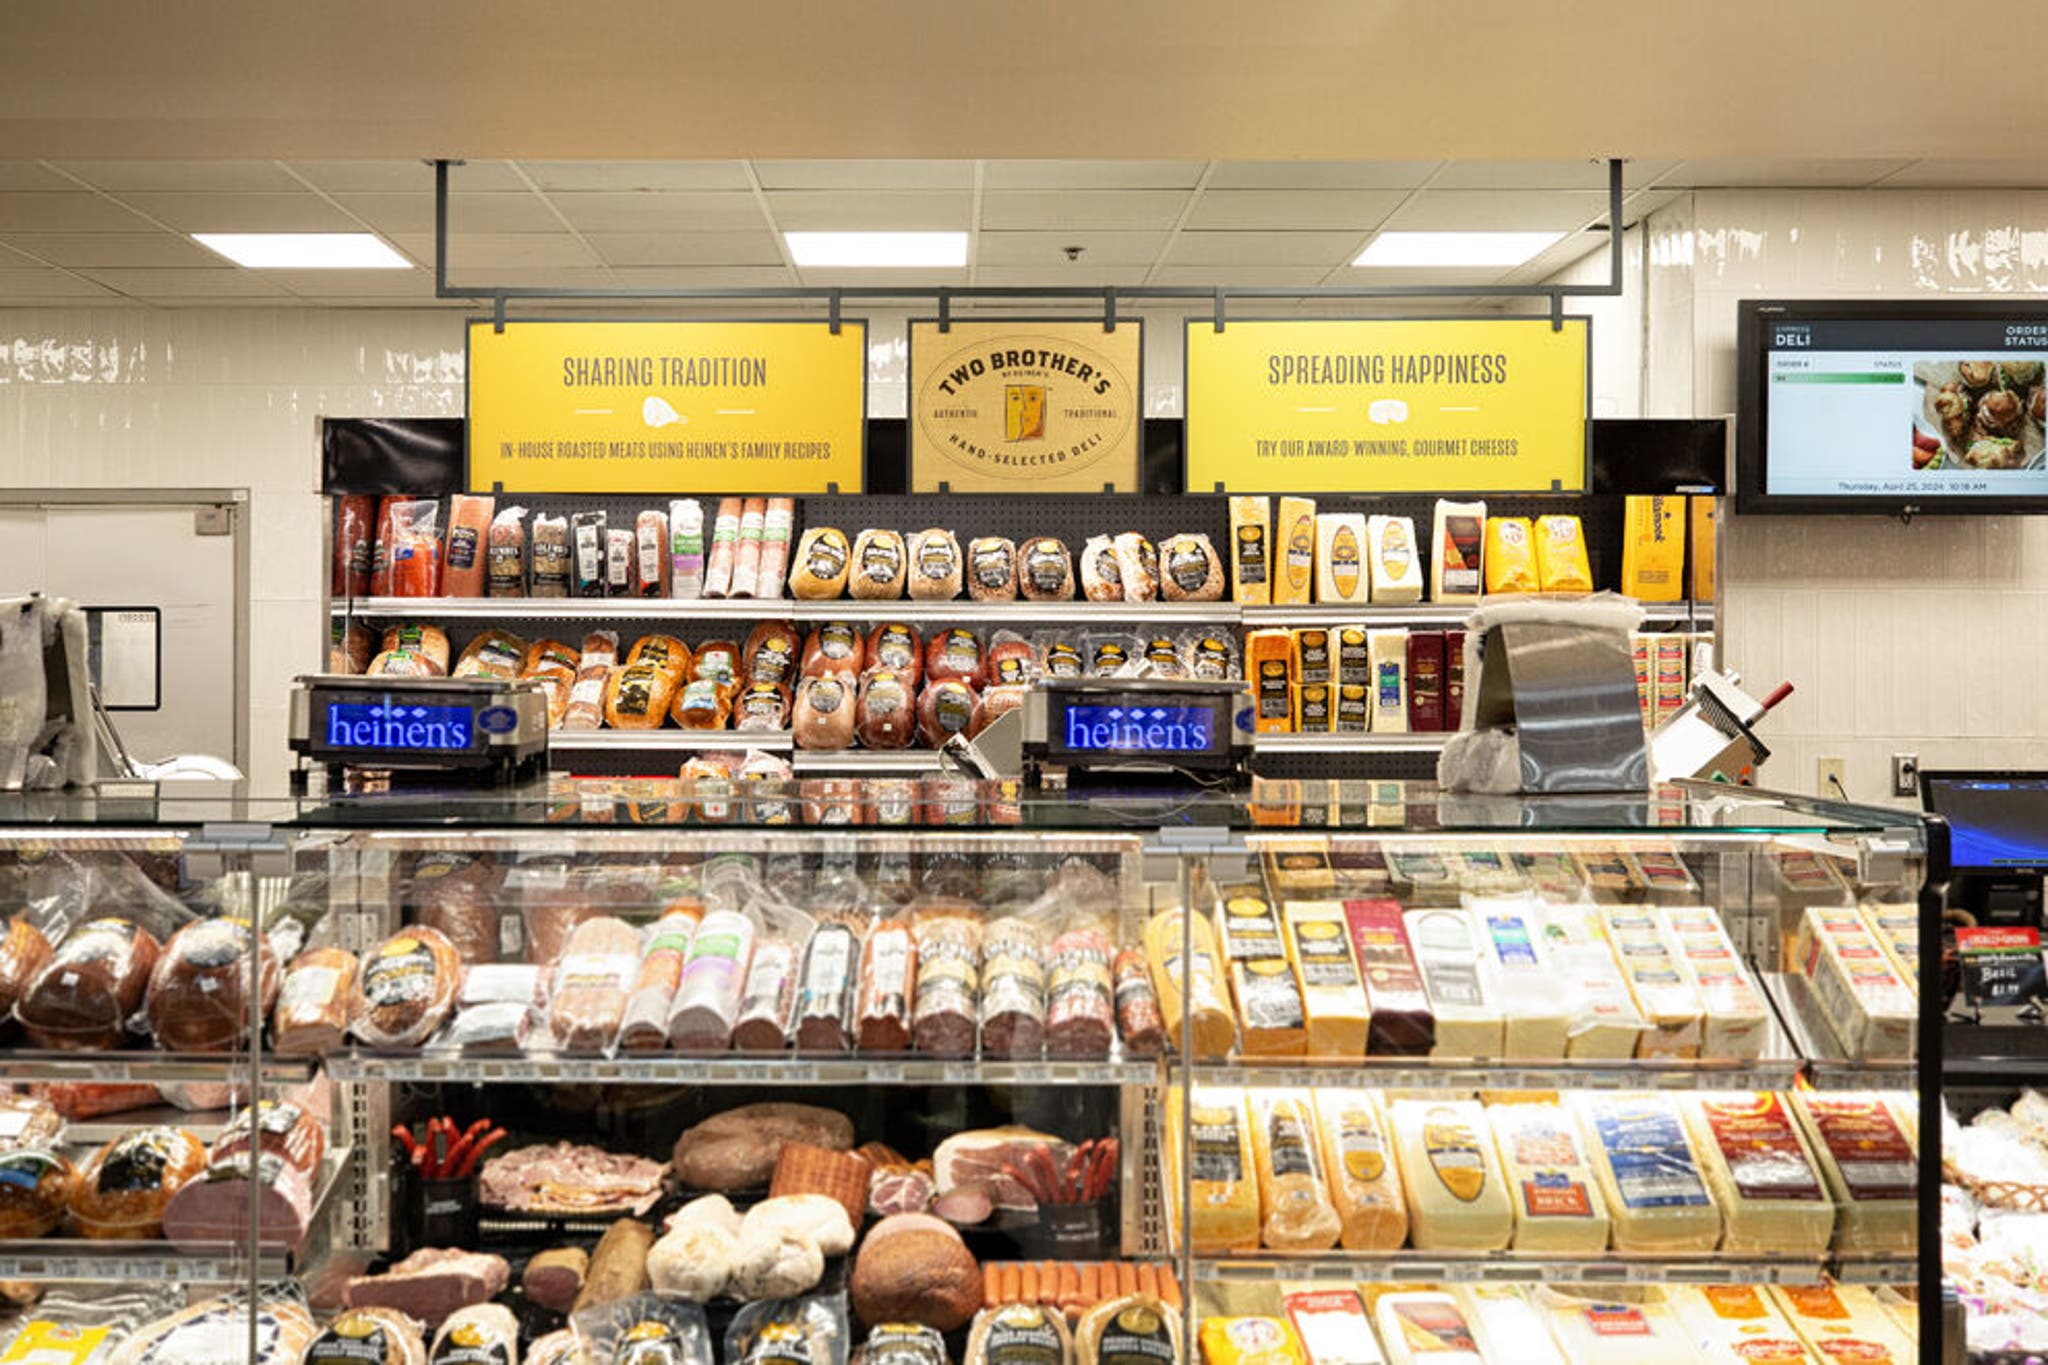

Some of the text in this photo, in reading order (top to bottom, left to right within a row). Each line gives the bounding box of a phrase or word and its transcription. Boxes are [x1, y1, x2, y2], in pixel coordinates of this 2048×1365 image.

[1776, 334, 1811, 346] DELI
[2006, 326, 2048, 336] ORDER
[2004, 337, 2048, 346] STATUS
[563, 357, 767, 387] SHARING TRADITION
[939, 350, 1111, 396] TWO BROTHER'S
[1268, 354, 1507, 385] SPREADING HAPPINESS
[933, 409, 978, 419] AUTHENTIC
[1064, 409, 1117, 419] TRADITIONAL
[500, 441, 831, 459] IN-HOUSE ROASTED MEATS USING HEINEN'S FAMILY RECIPES
[949, 432, 1103, 466] HAND-SELECTED DELI
[1256, 440, 1276, 457] TRY
[1280, 440, 1303, 457] OUR
[1413, 439, 1467, 457] GOURMET
[1470, 439, 1519, 456] CHEESES
[1883, 481, 1904, 491] April
[1972, 482, 1987, 491] AM
[329, 704, 467, 748] heinen's
[1066, 707, 1208, 750] heinen's
